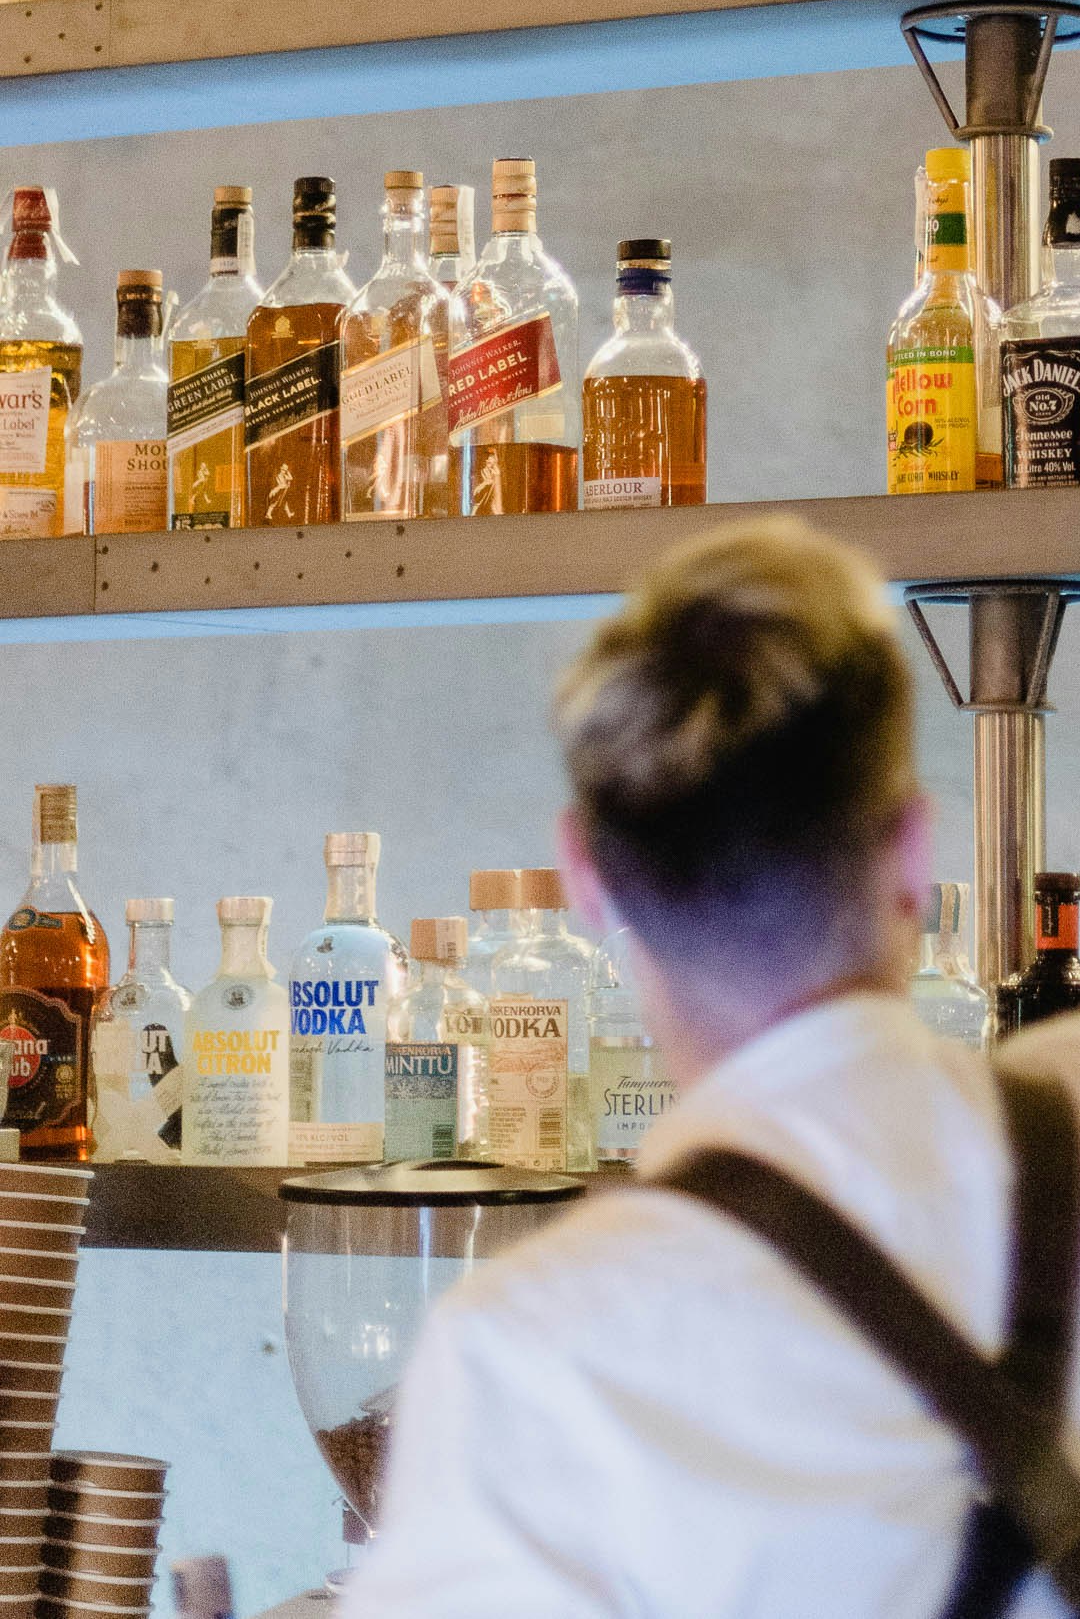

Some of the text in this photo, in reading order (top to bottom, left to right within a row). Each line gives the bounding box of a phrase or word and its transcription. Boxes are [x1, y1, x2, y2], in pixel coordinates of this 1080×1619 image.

[917, 349, 957, 360] IN BOND
[448, 350, 528, 397] RED LABEL
[450, 357, 485, 380] JOHNNIE
[375, 366, 414, 392] LABEL
[1002, 365, 1034, 398] JACK
[167, 391, 202, 413] GREEN
[204, 374, 238, 395] LABEL
[249, 381, 280, 400] JOHNNIE
[1034, 393, 1050, 401] Old
[245, 393, 280, 416] BLACK
[897, 394, 937, 417] Corn
[1028, 399, 1057, 412] No.7
[1014, 429, 1073, 442] Tennessee
[1016, 448, 1073, 460] WHISKEY
[1043, 461, 1061, 473] 40%
[584, 481, 643, 496] ABERLOUR
[290, 980, 379, 1008] BSOLUT
[489, 1005, 562, 1018] SKENKORVA
[13, 1038, 48, 1055] ana
[192, 1030, 280, 1053] ABSOLUT
[327, 1039, 375, 1055] Vodka
[386, 1044, 452, 1056] KENKORVA
[11, 1056, 31, 1077] ub
[196, 1052, 272, 1075] CITRON
[385, 1055, 453, 1076] MINTTU
